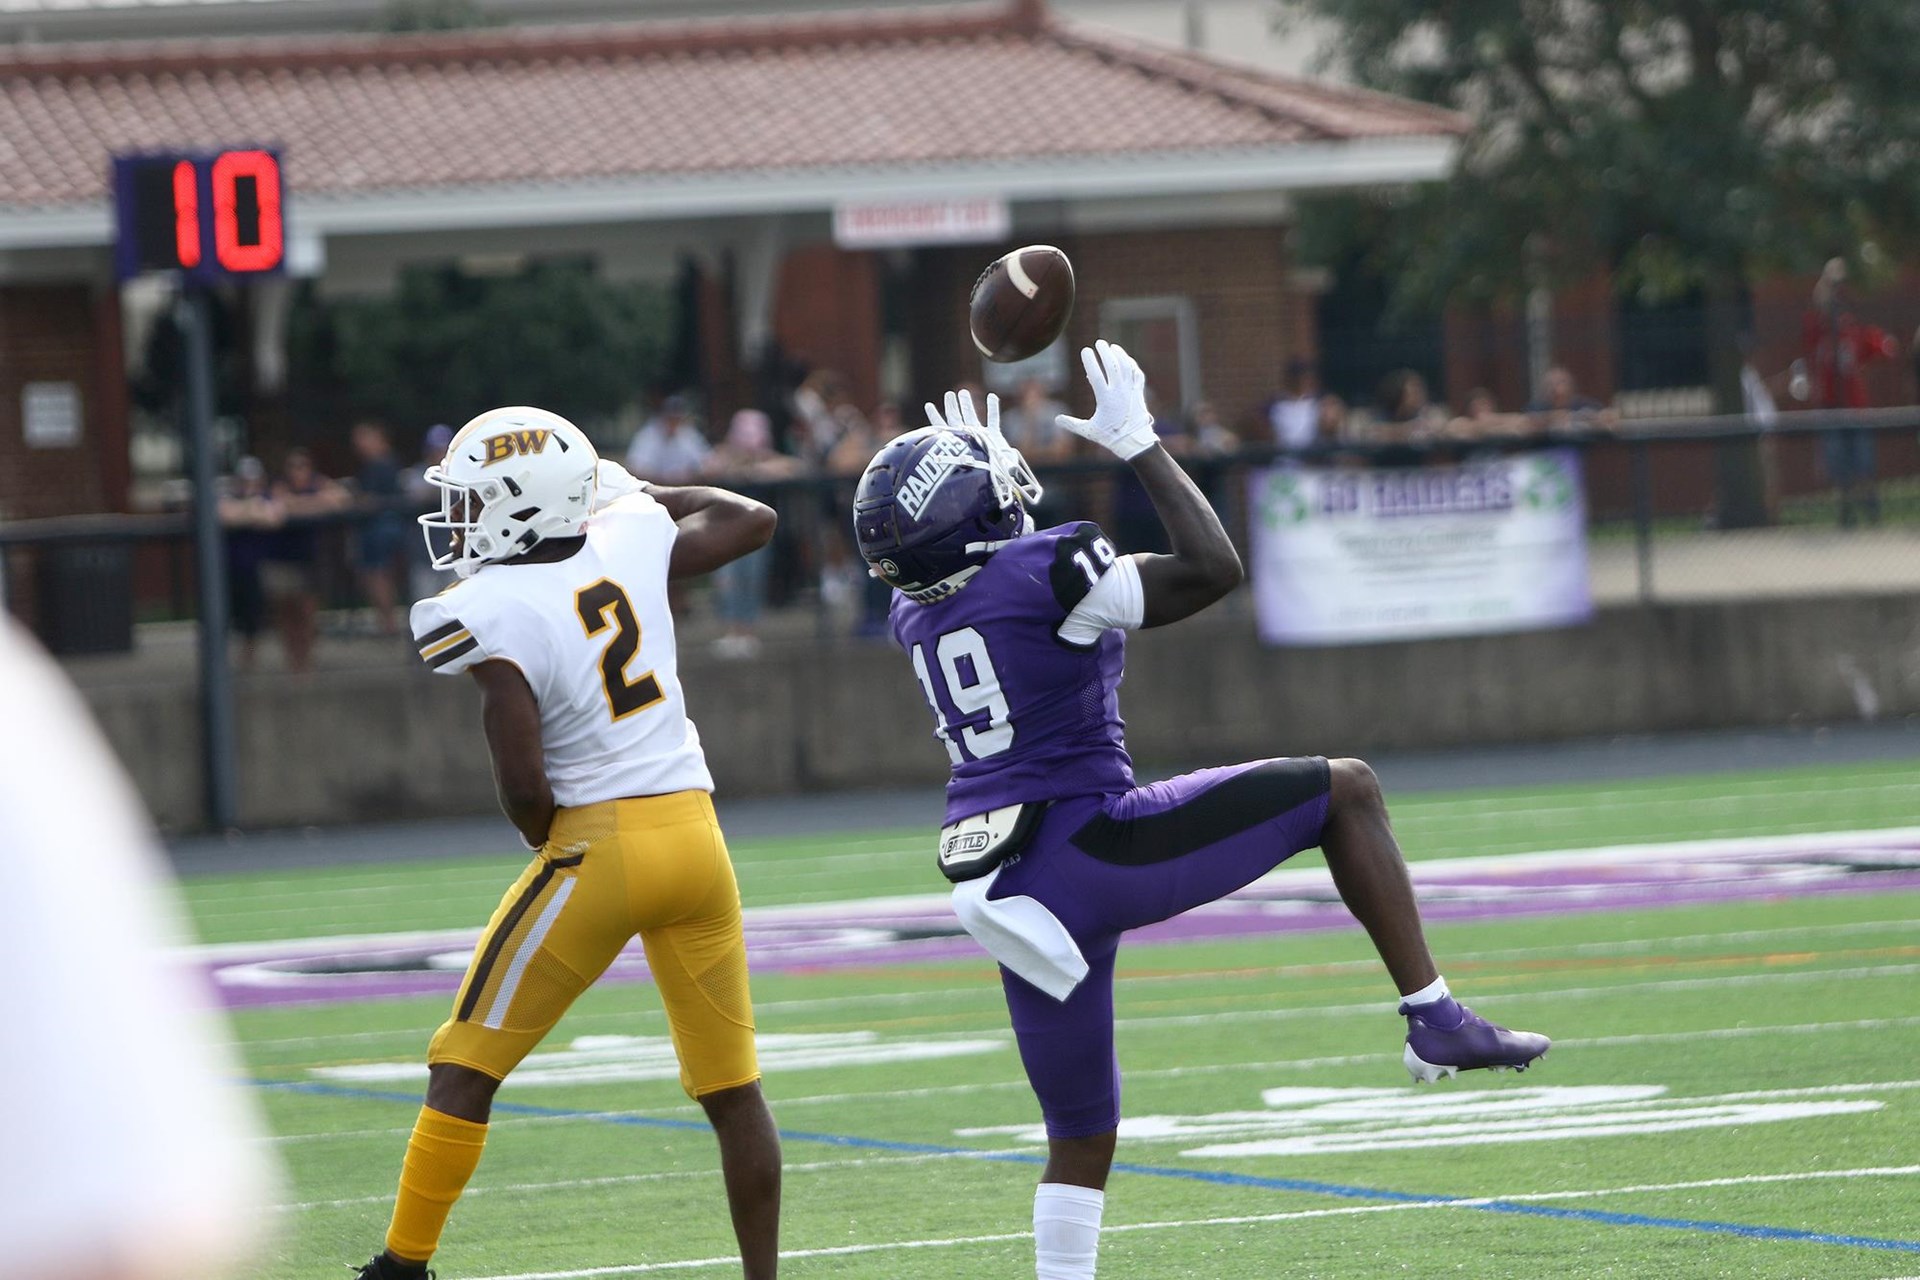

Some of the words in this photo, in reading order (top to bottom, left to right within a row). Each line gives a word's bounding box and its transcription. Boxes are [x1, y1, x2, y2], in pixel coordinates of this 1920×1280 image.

[172, 150, 284, 272] 10
[481, 429, 554, 468] BW
[896, 431, 969, 517] RAIDERS
[574, 576, 667, 723] 2
[912, 626, 1015, 764] 19
[947, 836, 985, 854] BATTLE
